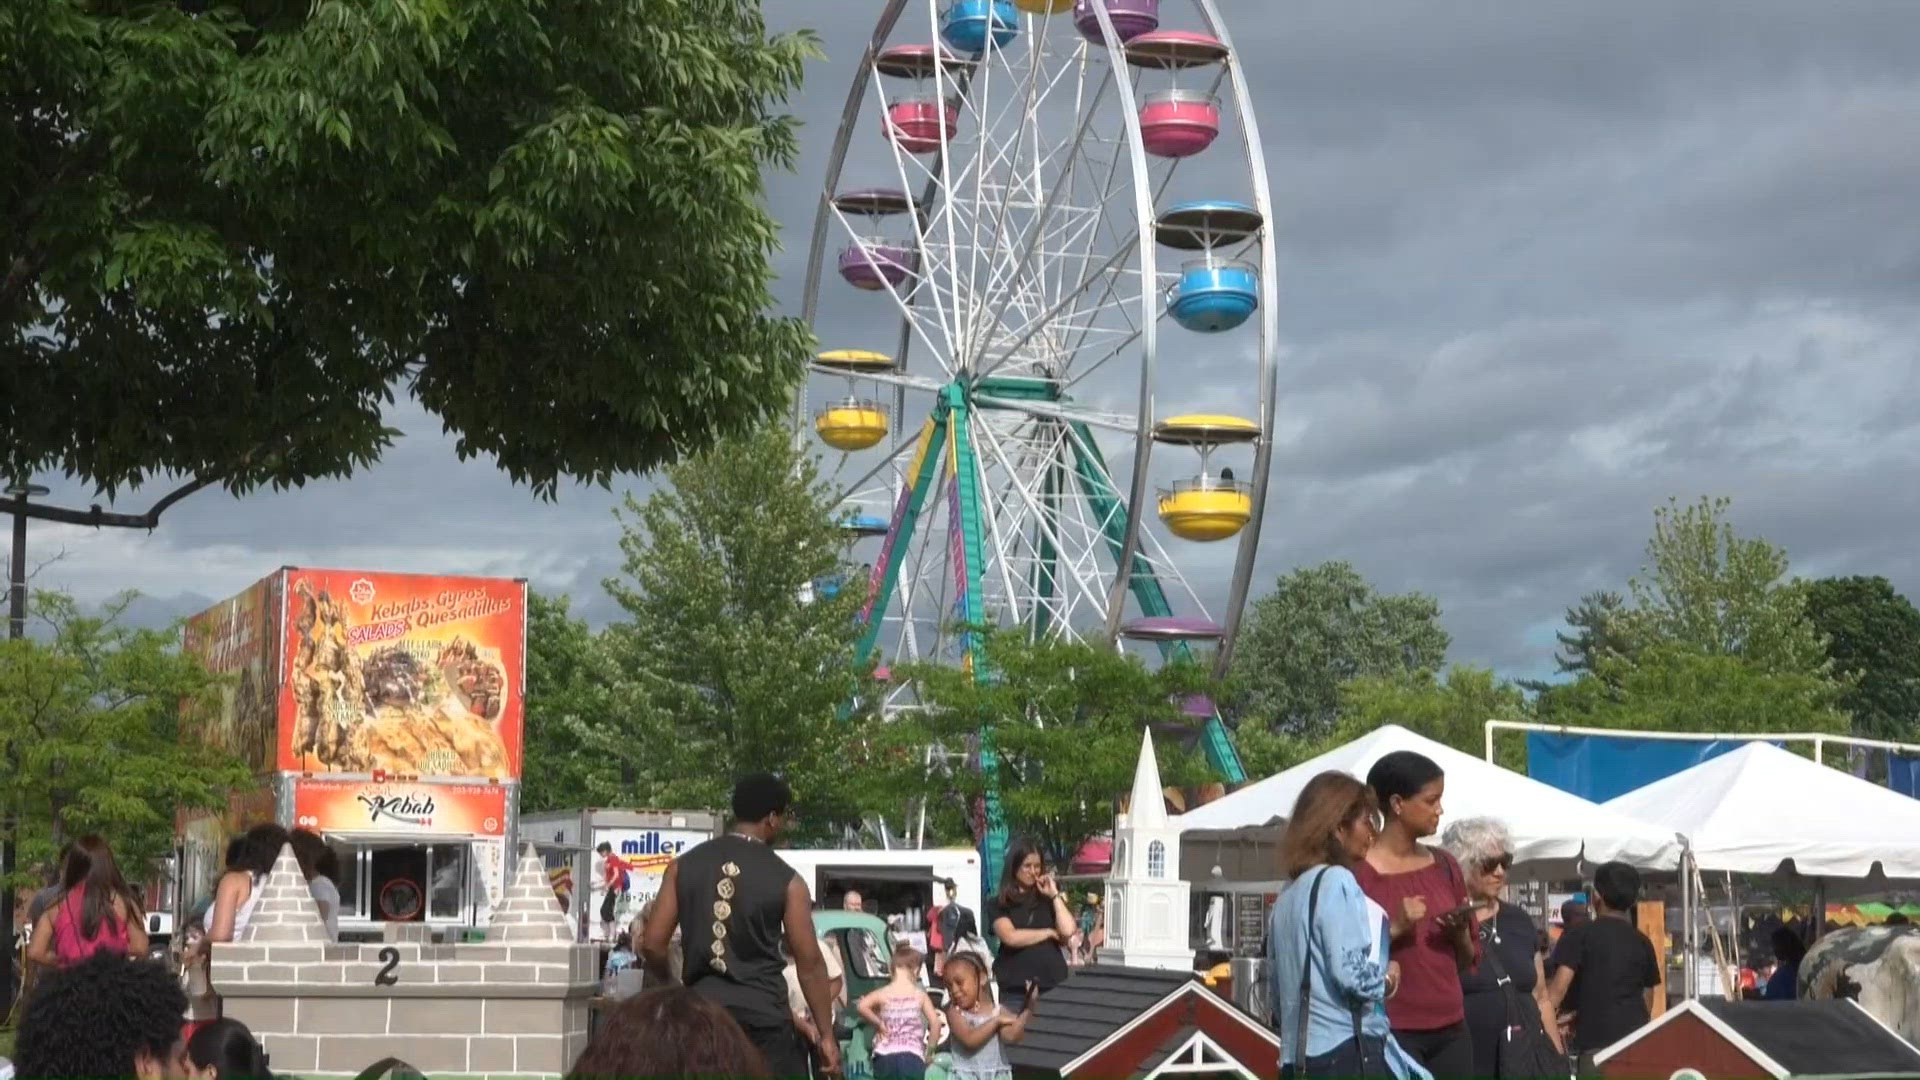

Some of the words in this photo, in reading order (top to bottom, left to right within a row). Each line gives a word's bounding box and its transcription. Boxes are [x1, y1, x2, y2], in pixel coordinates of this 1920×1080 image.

[348, 619, 406, 645] SALADS
[416, 596, 512, 629] Quesadillas
[371, 597, 435, 621] Kebabs,
[437, 586, 487, 609] Gyros
[360, 795, 435, 822] Kebab
[621, 831, 685, 854] miller
[375, 946, 400, 987] 2
